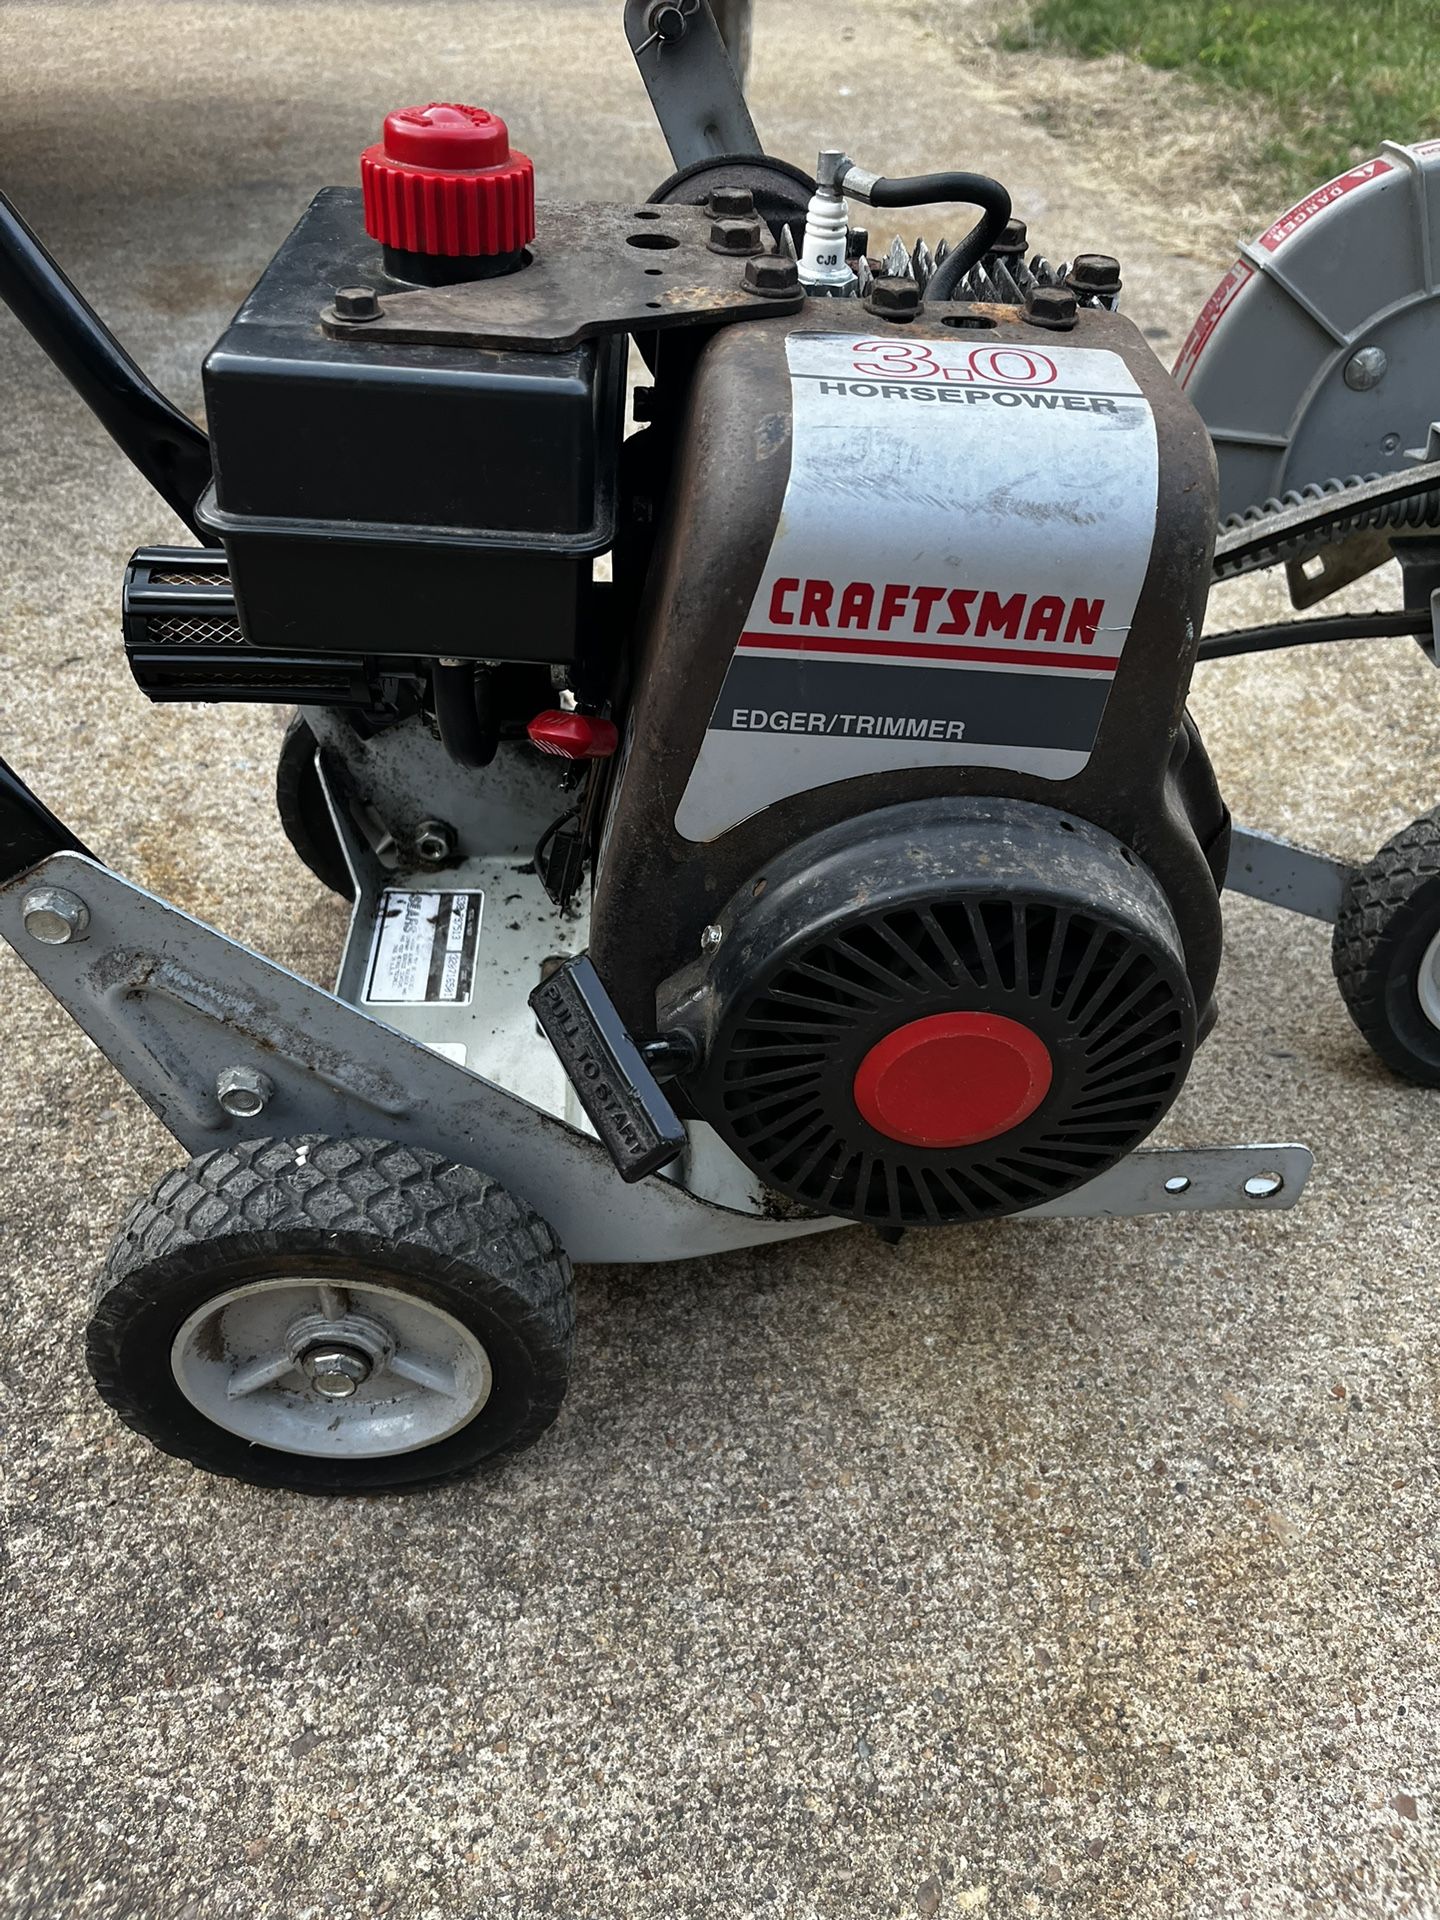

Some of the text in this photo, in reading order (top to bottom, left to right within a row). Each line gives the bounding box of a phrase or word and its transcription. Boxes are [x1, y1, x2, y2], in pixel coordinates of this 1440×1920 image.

[1272, 187, 1344, 242] DANGER
[816, 254, 838, 266] CJ8
[851, 340, 1058, 387] 3.0
[818, 380, 1119, 415] HORSEPOWER
[767, 576, 1106, 646] CRAFTSMAN
[731, 708, 966, 740] EDGER/TRIMMER
[403, 893, 422, 933] SEARS
[543, 982, 648, 1155] PULL TO START
